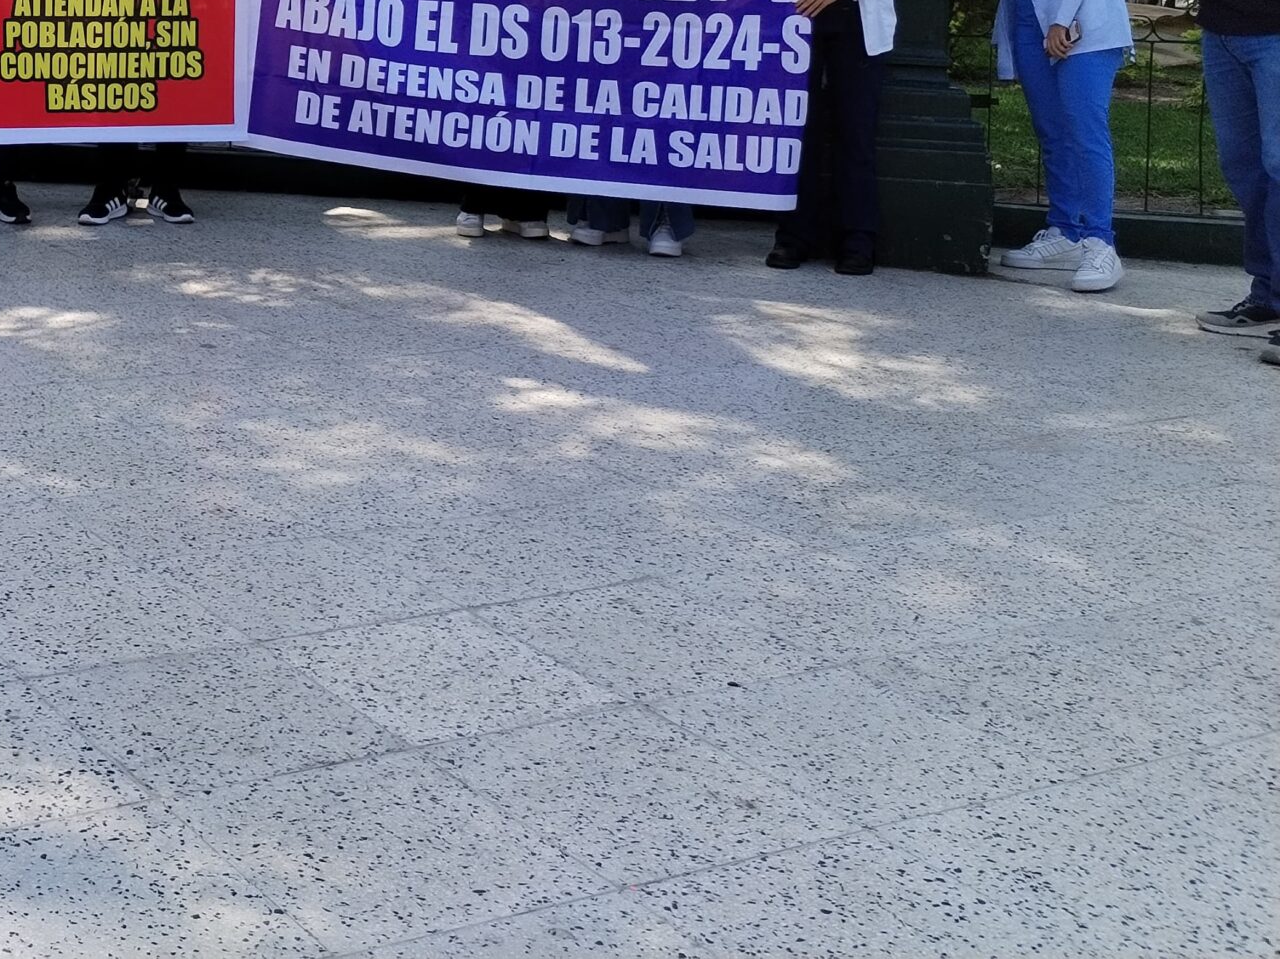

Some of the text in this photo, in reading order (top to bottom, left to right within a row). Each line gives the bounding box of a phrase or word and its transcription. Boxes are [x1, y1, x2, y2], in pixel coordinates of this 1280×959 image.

[156, 20, 197, 47] SIN
[414, 0, 459, 54] EL
[469, 2, 529, 60] DS
[0, 51, 202, 80] CONOCIMIENTOS
[287, 44, 809, 127] EN DEFENSA DE LA CALIDAD
[47, 79, 156, 111] BÁSICOS
[294, 90, 802, 175] DE ATENCIÓN DE LA SALUD
